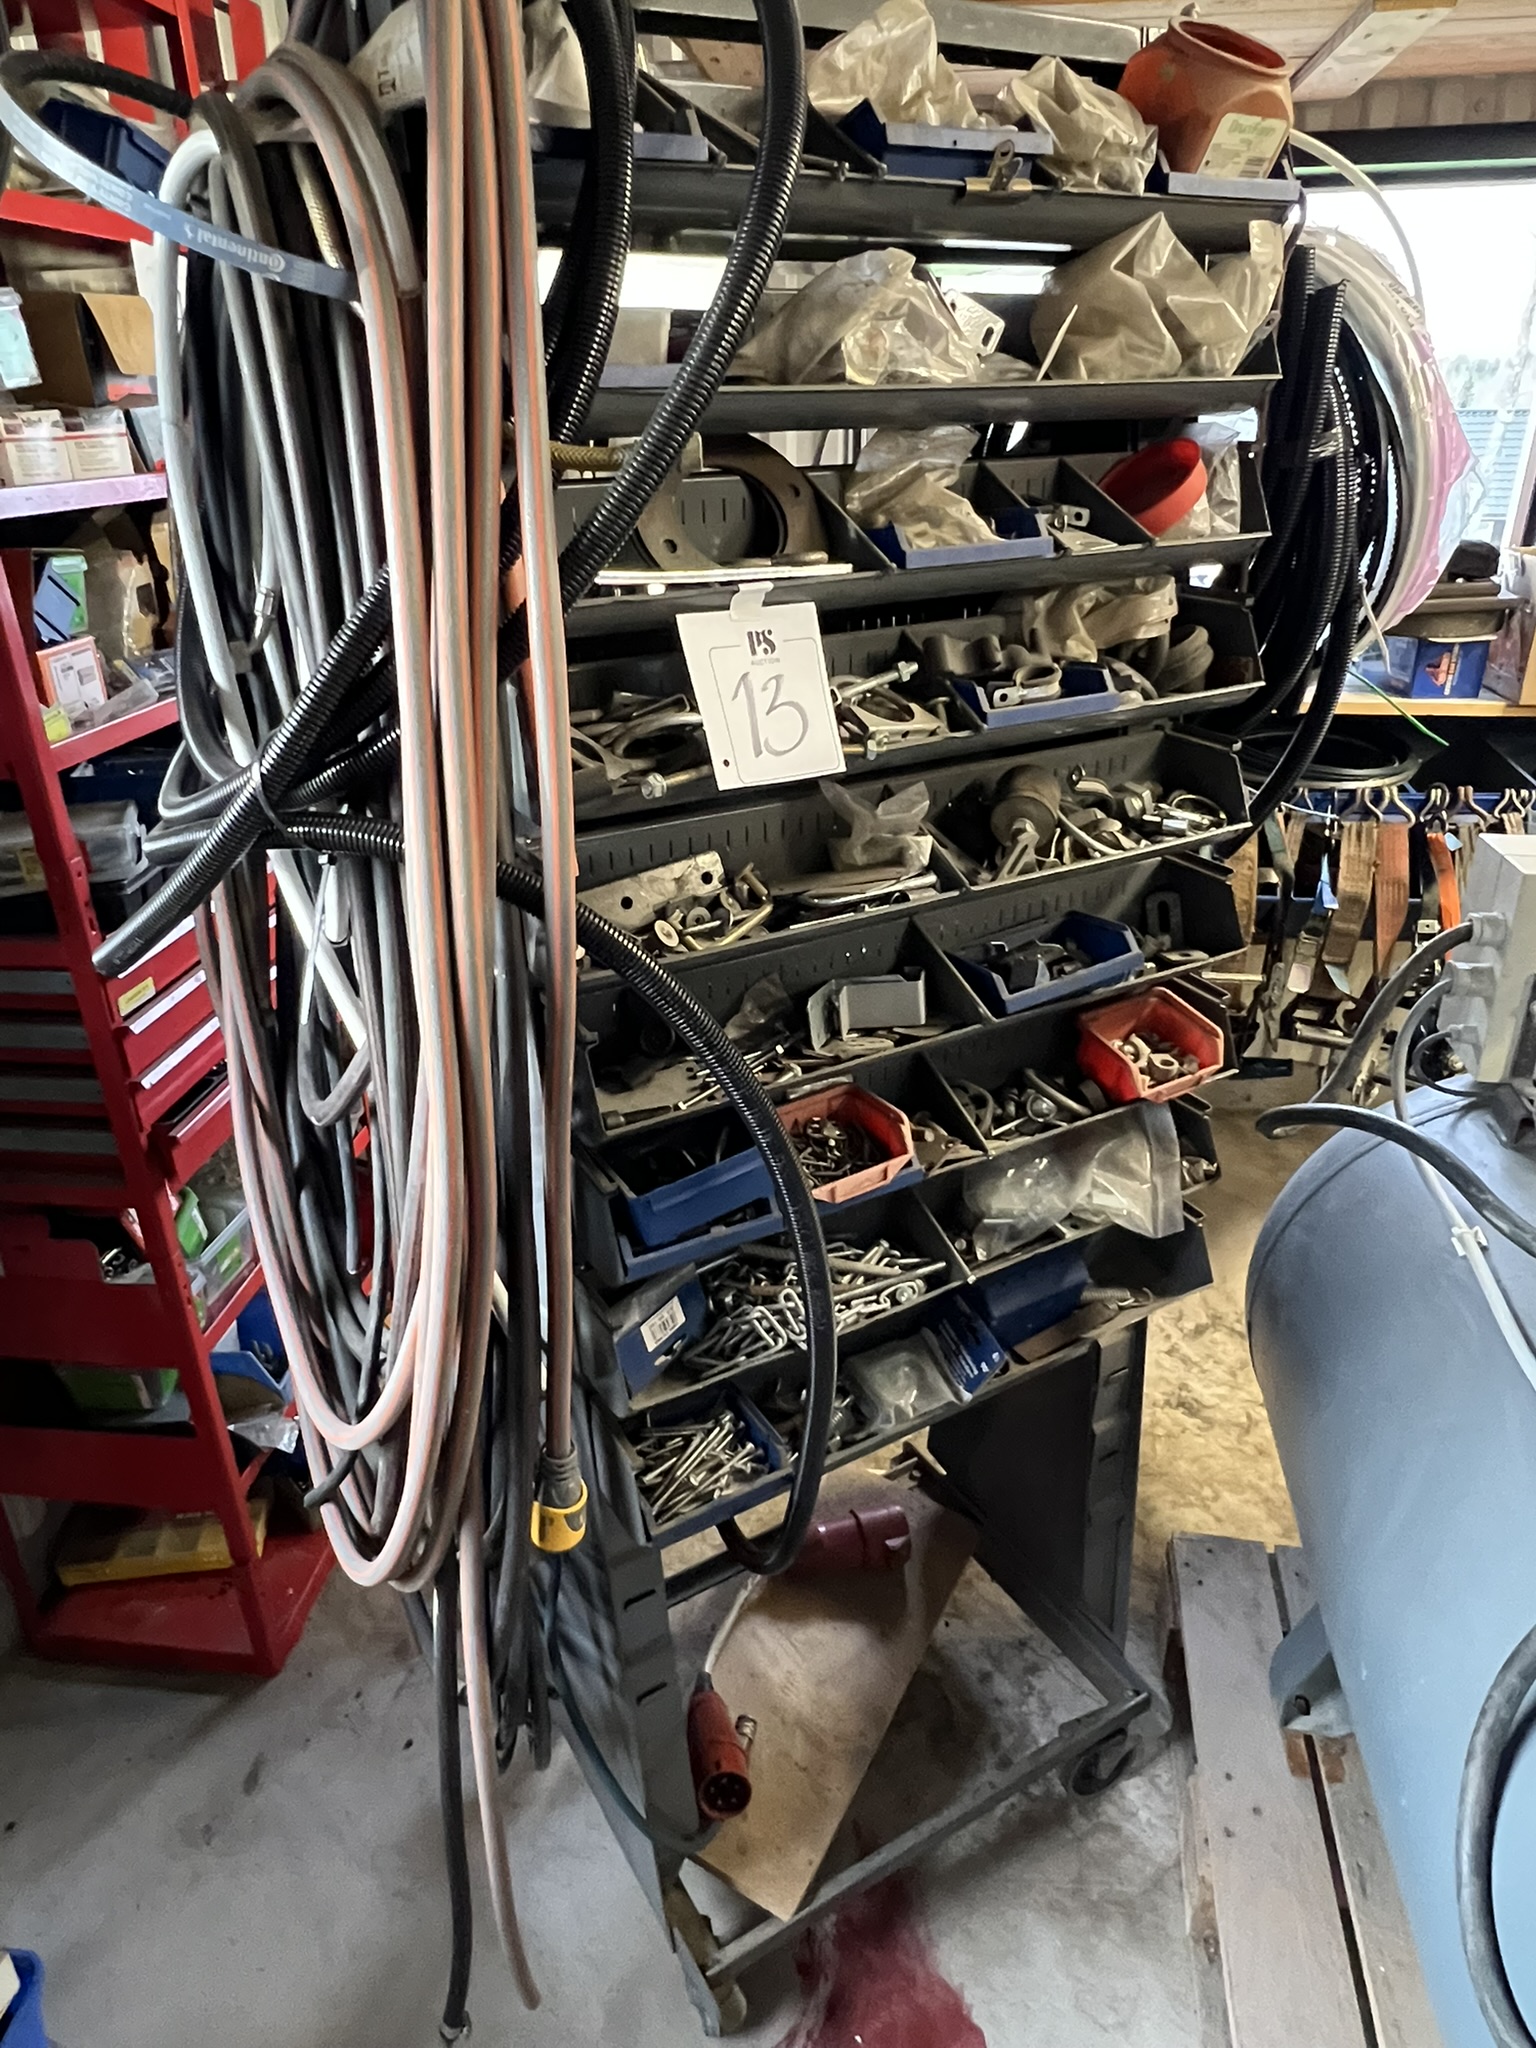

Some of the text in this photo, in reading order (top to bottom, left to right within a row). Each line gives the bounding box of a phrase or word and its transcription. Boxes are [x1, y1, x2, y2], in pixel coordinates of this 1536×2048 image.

[197, 228, 286, 273] Continental
[747, 629, 776, 656] PS
[731, 671, 809, 758] 13
